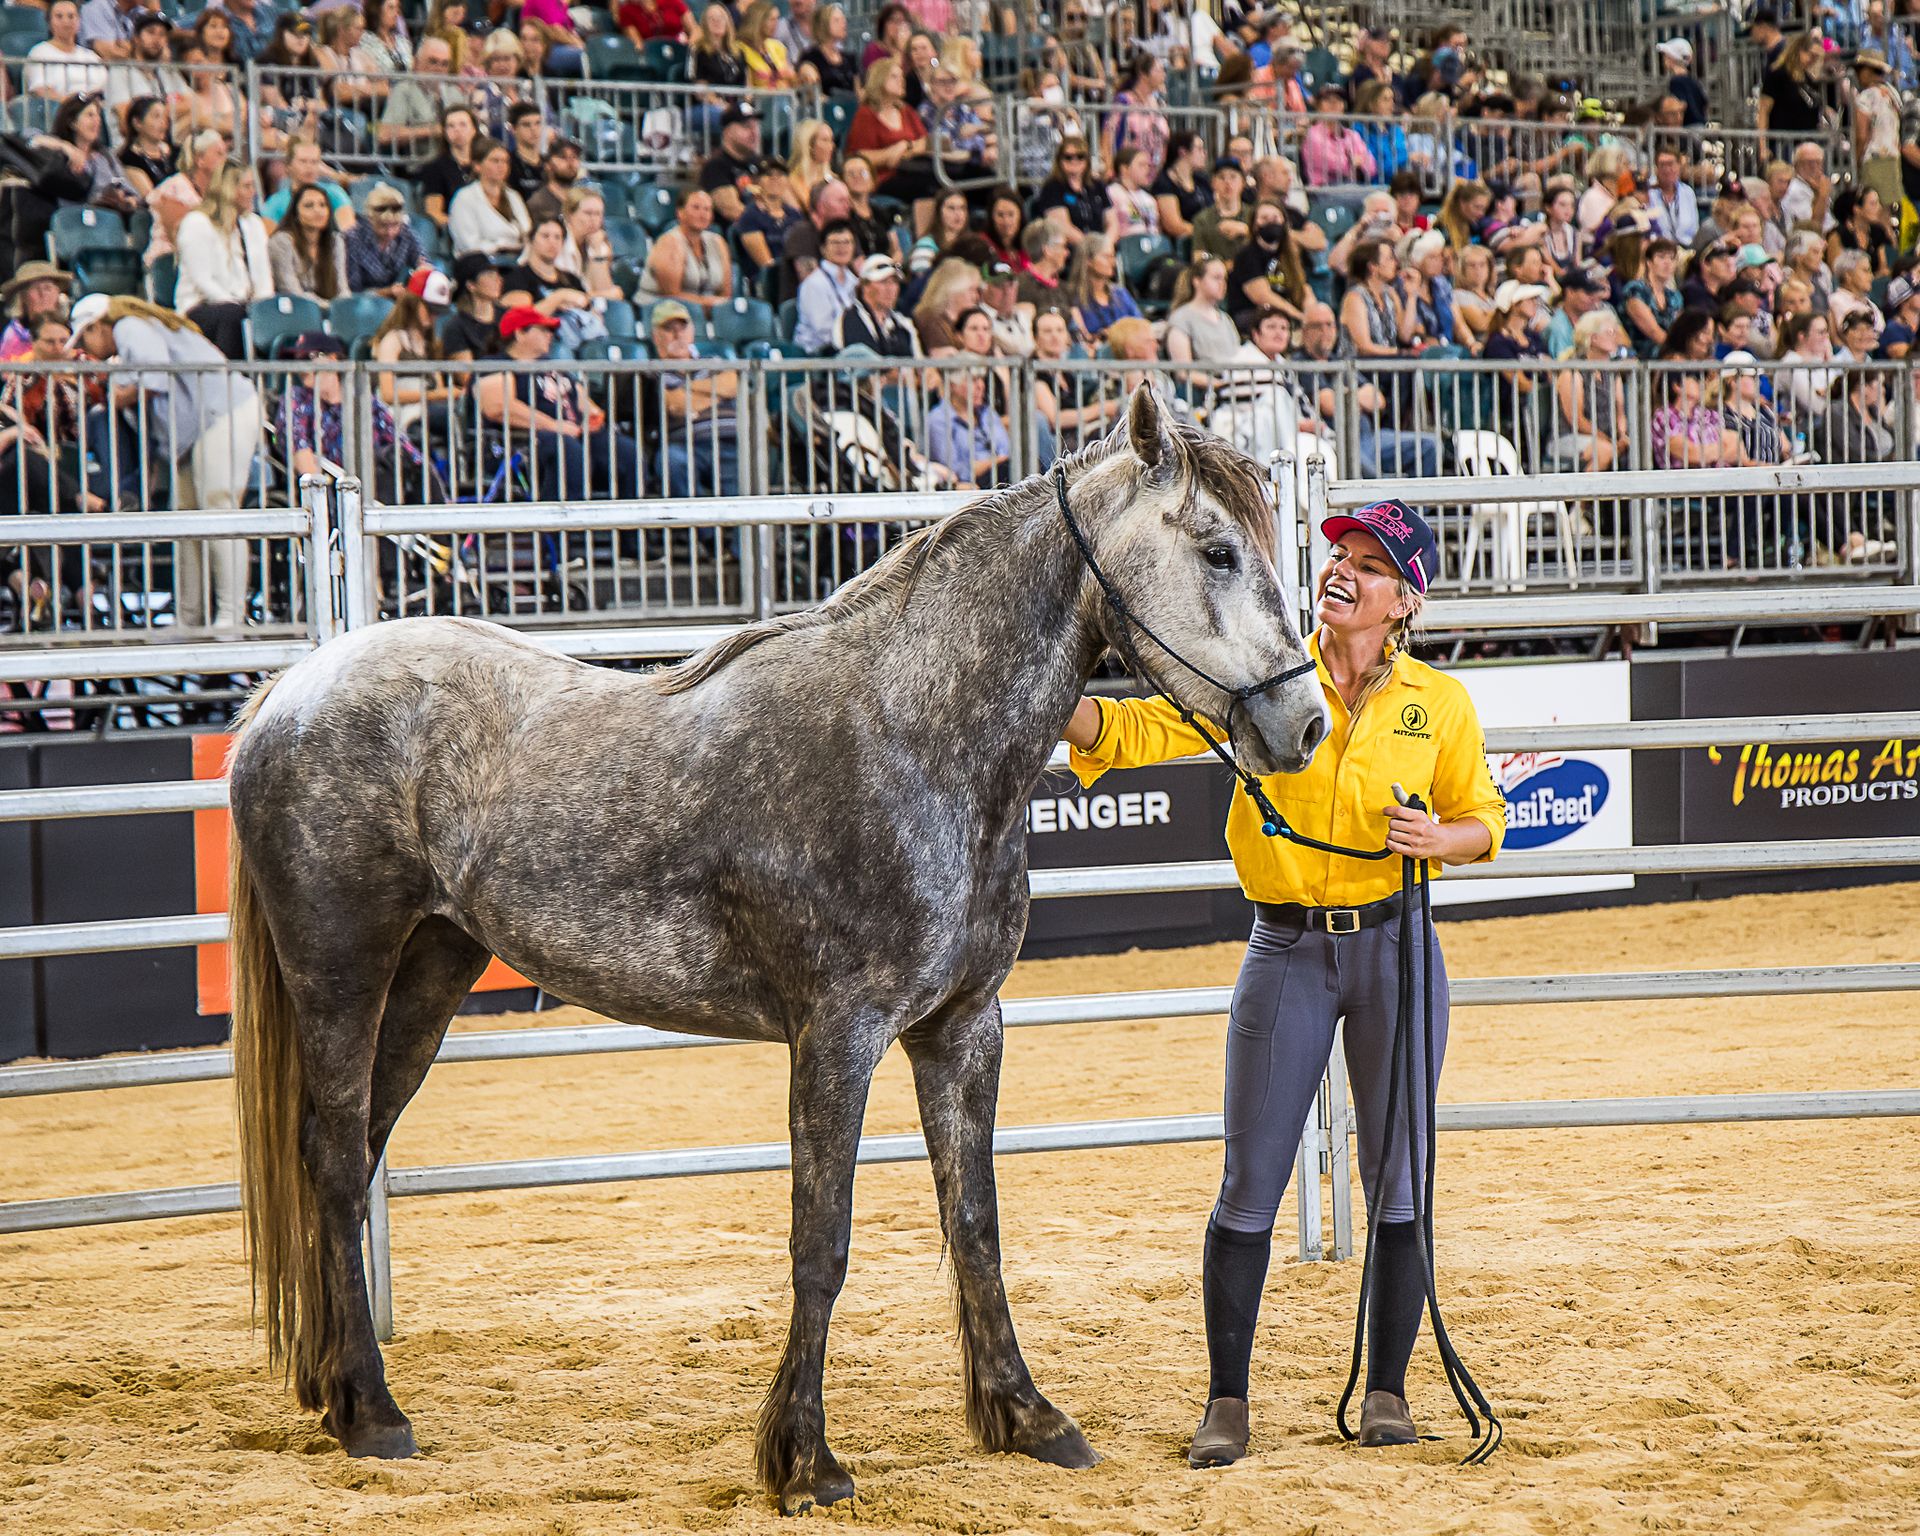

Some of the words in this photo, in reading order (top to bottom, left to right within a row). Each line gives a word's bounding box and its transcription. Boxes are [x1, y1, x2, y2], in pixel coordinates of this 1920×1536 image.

[1387, 521, 1407, 540] DAN
[1393, 729, 1432, 740] MITAVITE
[1708, 744, 1861, 807] Thomas
[1780, 779, 1919, 809] PRODUCTS
[1026, 790, 1171, 835] ENGER
[1506, 783, 1593, 830] asiFeed
